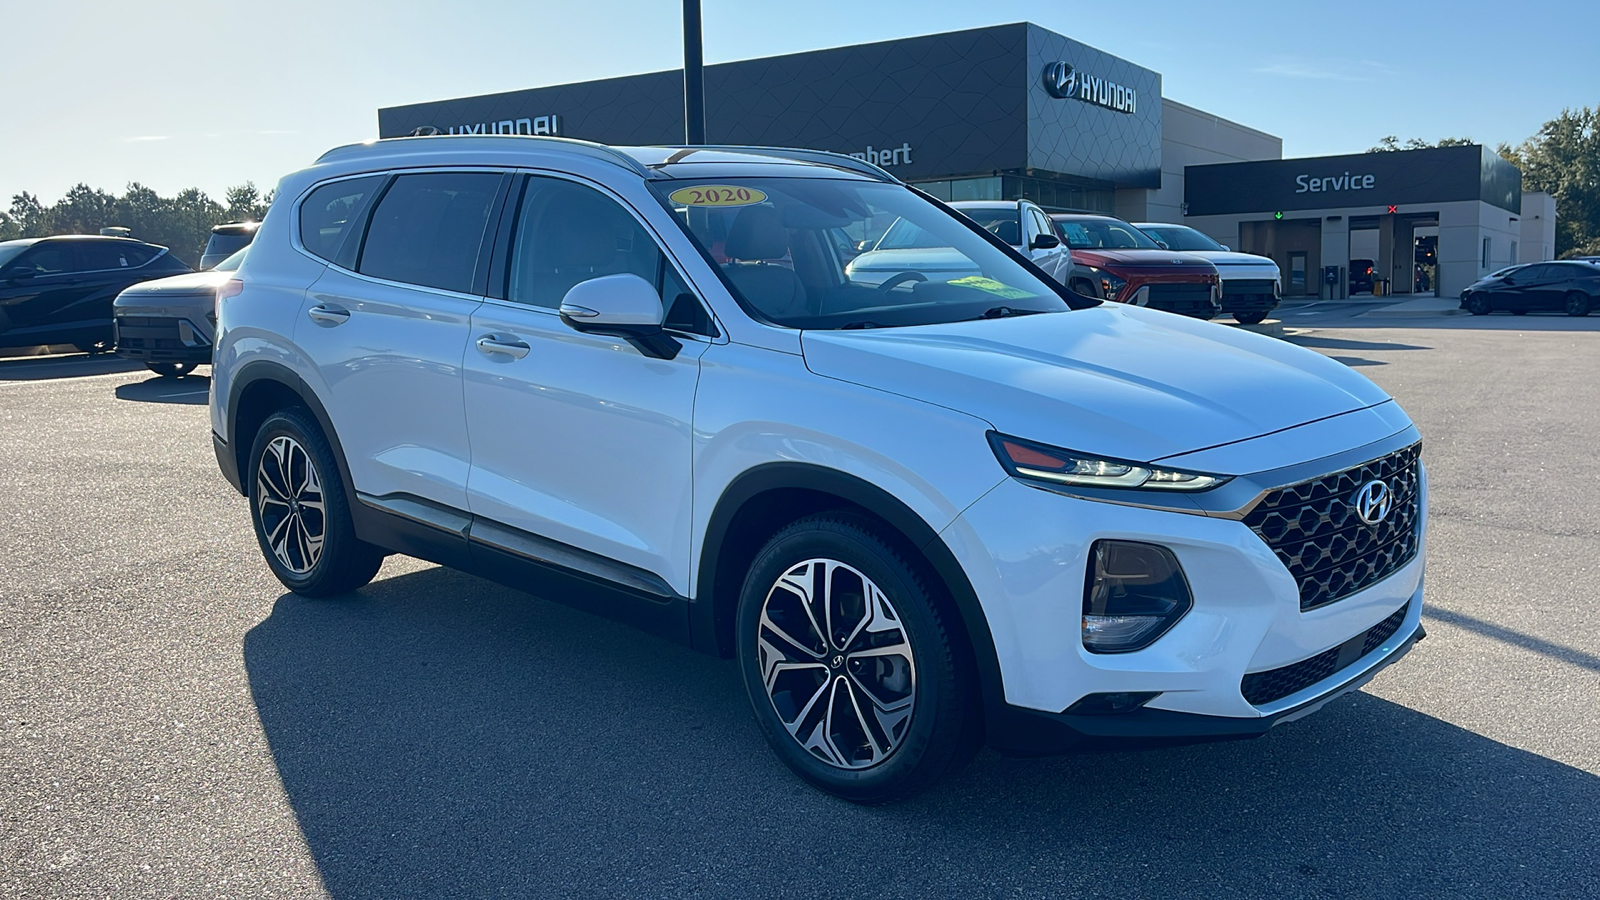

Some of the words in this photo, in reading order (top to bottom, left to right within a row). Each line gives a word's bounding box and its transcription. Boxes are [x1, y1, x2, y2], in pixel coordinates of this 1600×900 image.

[1081, 72, 1136, 114] HYUNDAI
[1295, 171, 1375, 193] Service
[689, 188, 751, 204] 2020
